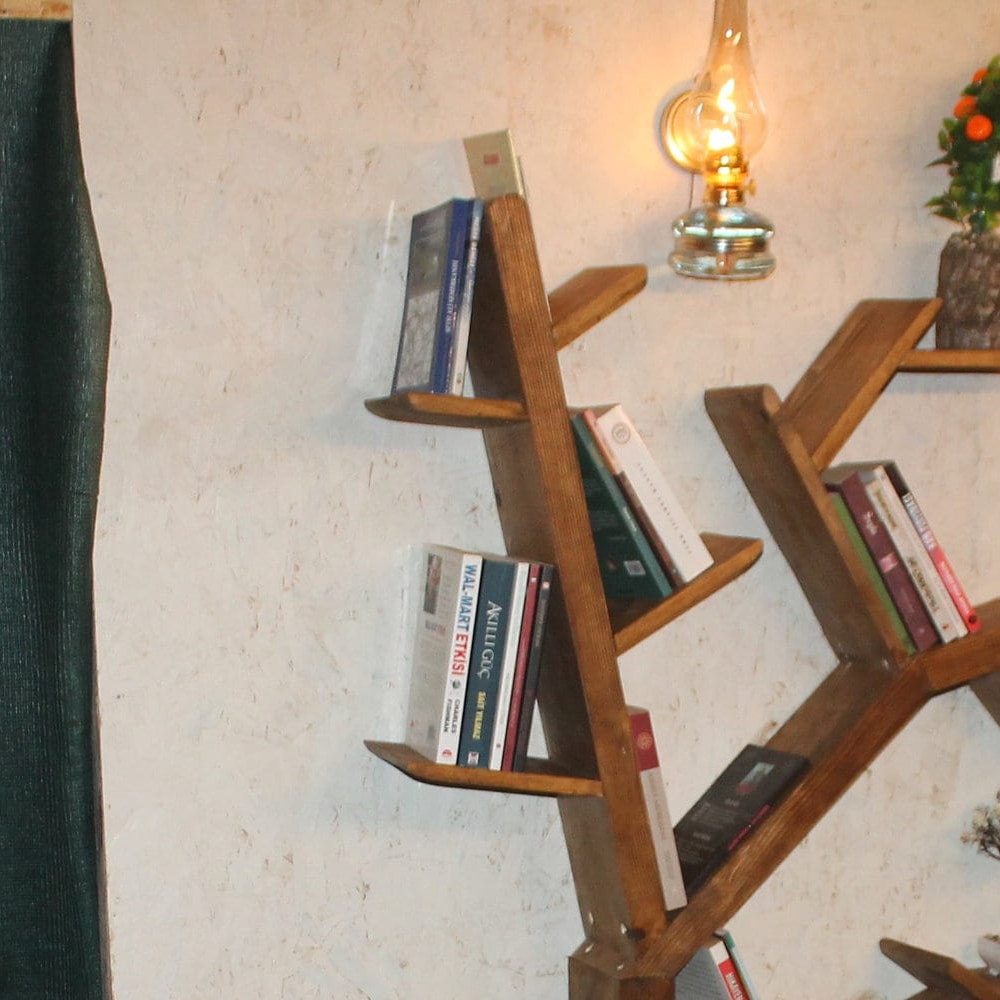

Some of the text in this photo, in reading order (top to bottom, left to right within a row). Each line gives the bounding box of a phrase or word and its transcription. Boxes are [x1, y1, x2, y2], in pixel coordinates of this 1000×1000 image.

[458, 564, 478, 632] WAL-MART
[477, 601, 502, 680] AKILLI GÜÇ
[451, 699, 460, 734] CHARLES
